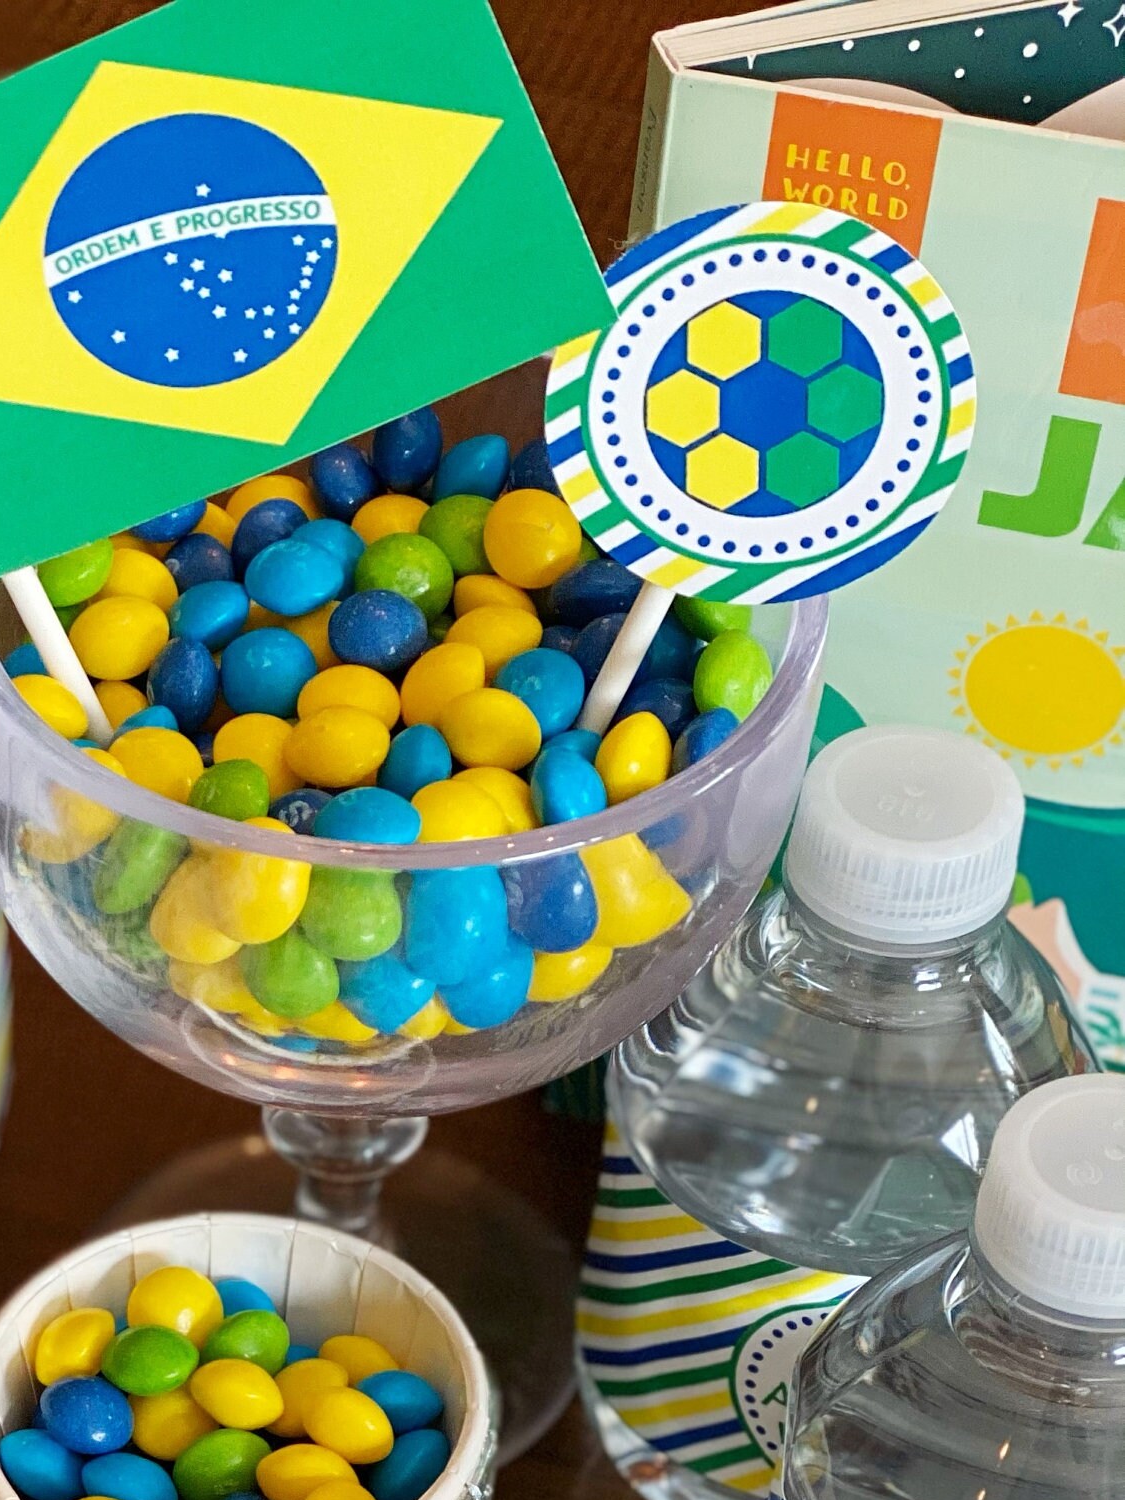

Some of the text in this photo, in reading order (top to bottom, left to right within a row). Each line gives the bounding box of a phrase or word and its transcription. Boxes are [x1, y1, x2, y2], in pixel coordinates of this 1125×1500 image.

[785, 143, 911, 191] HELLO,
[782, 177, 909, 221] WORLD
[54, 200, 322, 275] ORDEM E PROGRESSO
